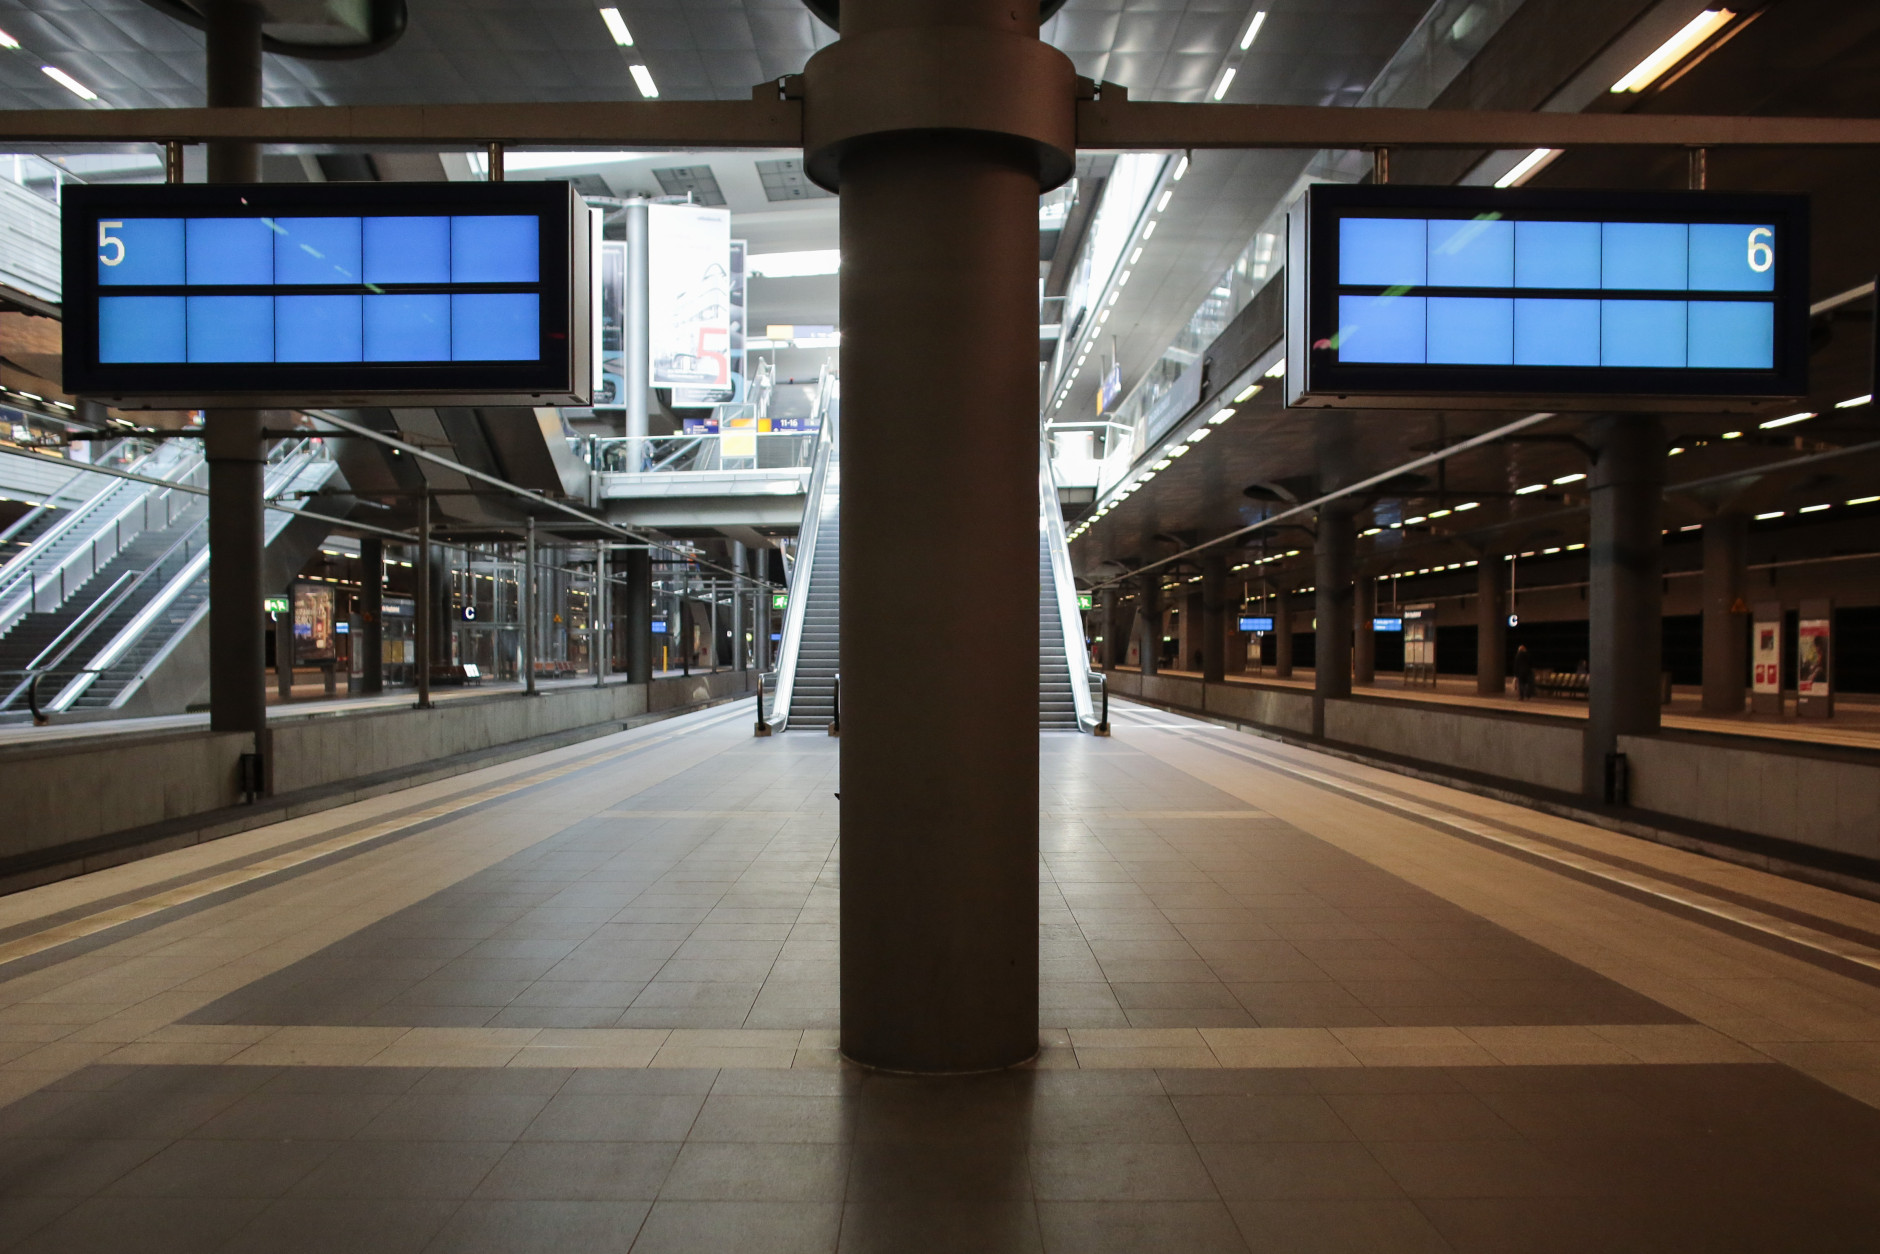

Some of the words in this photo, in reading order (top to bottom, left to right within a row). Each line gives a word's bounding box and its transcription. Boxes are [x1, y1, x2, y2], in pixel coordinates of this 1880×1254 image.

[99, 221, 125, 266] 5
[1747, 227, 1773, 272] 6
[696, 327, 727, 384] 5
[781, 419, 798, 427] 11-16
[465, 606, 475, 619] C
[1509, 615, 1518, 627] C
